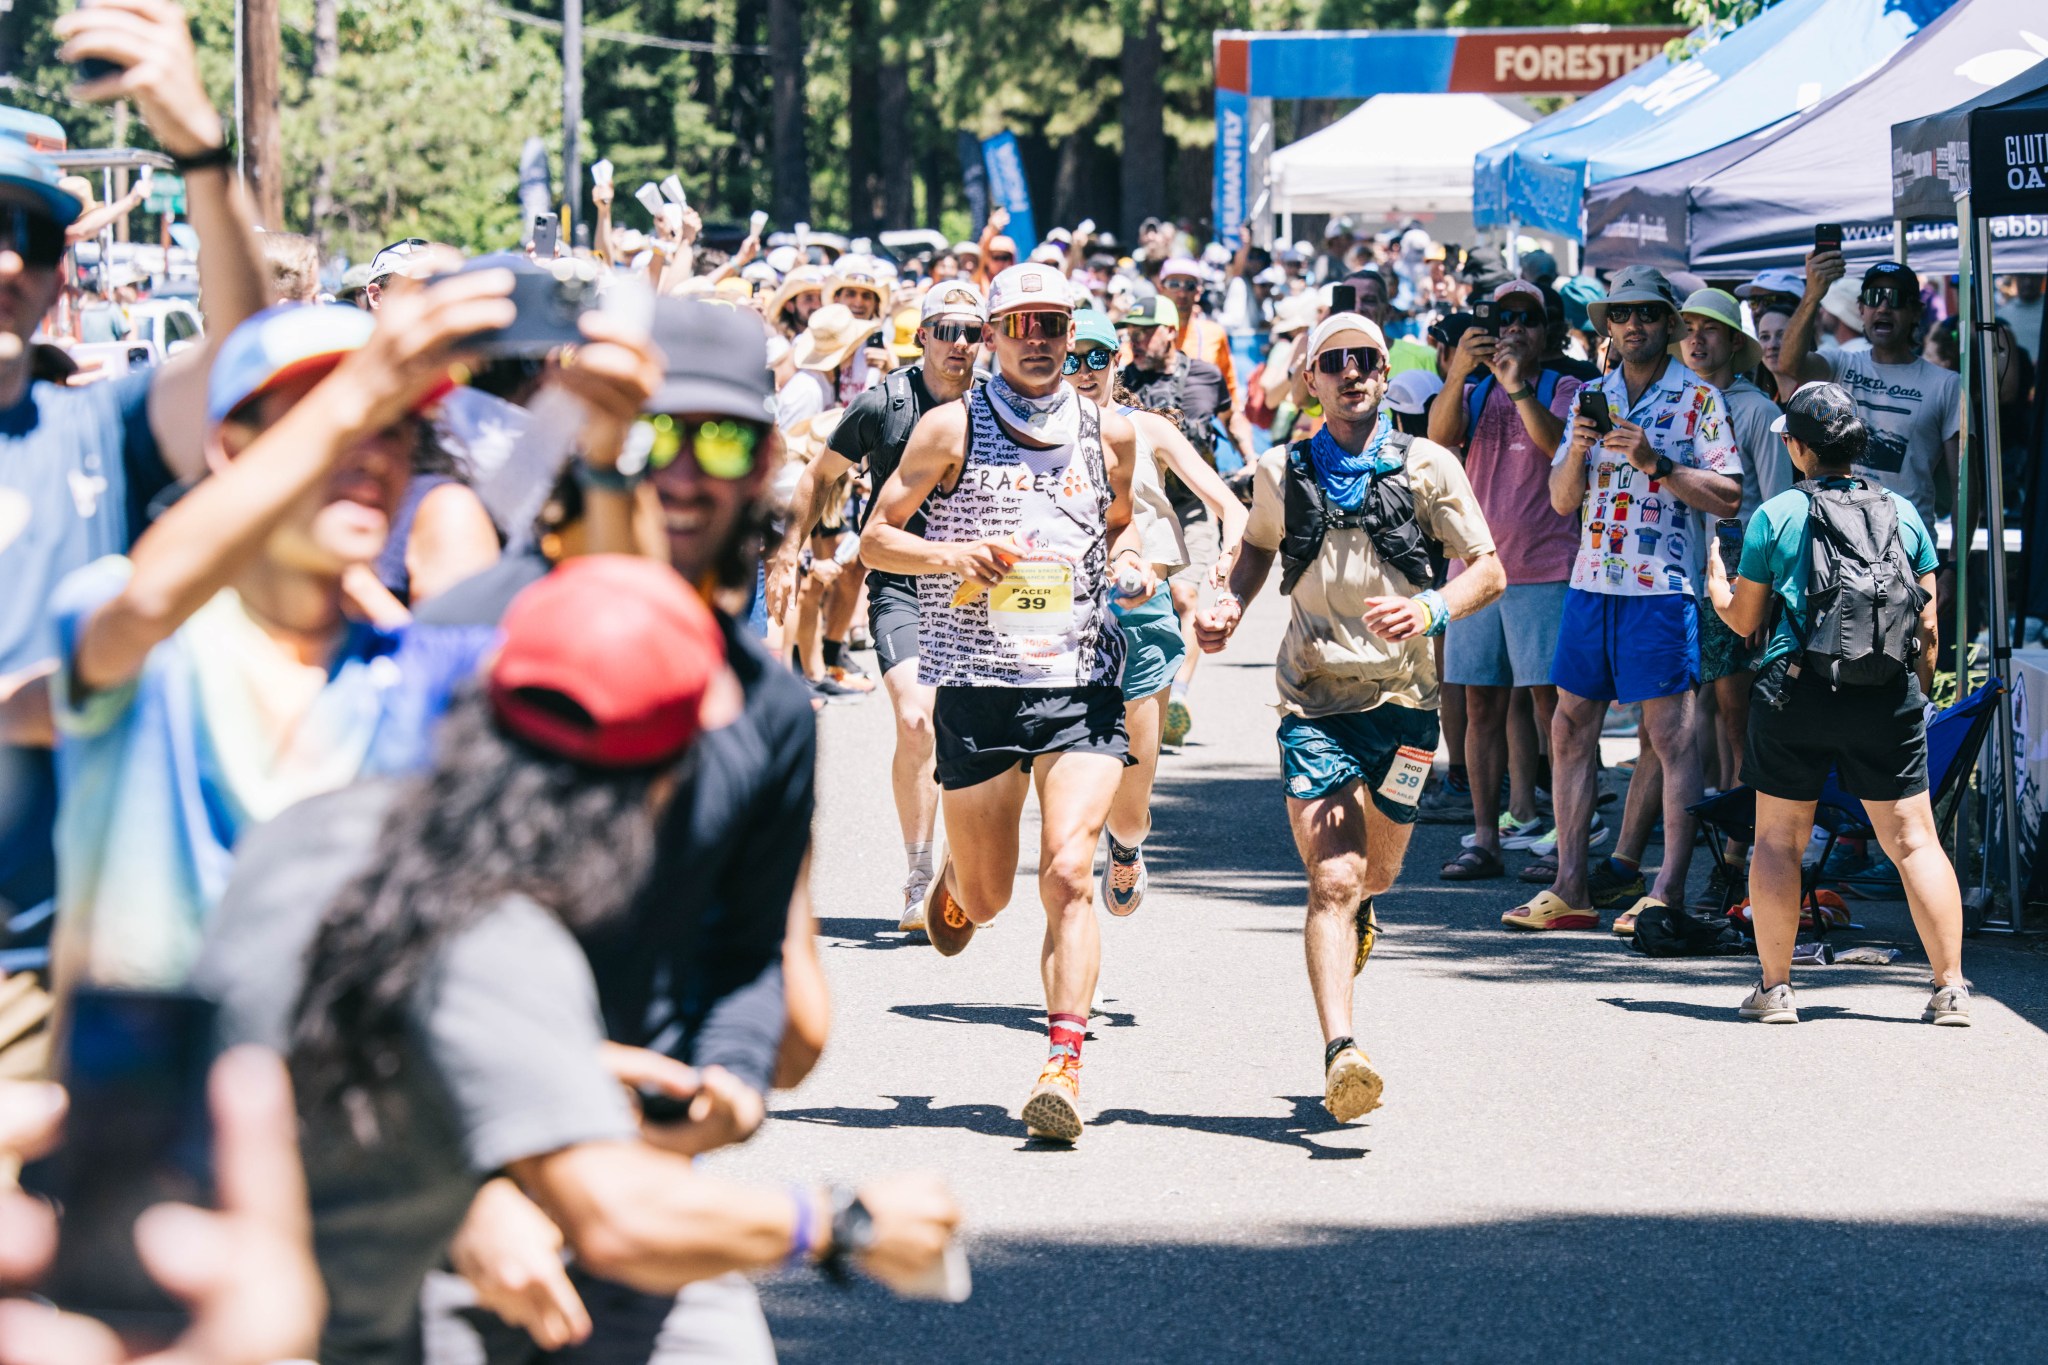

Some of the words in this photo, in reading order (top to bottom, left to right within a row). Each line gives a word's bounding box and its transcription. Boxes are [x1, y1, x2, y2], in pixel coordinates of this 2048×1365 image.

[1223, 107, 1242, 147] FLY
[2008, 166, 2048, 190] OA
[1888, 385, 1923, 397] Oats
[1017, 597, 1046, 609] 39
[1404, 763, 1423, 773] ROD
[1396, 772, 1420, 788] 39
